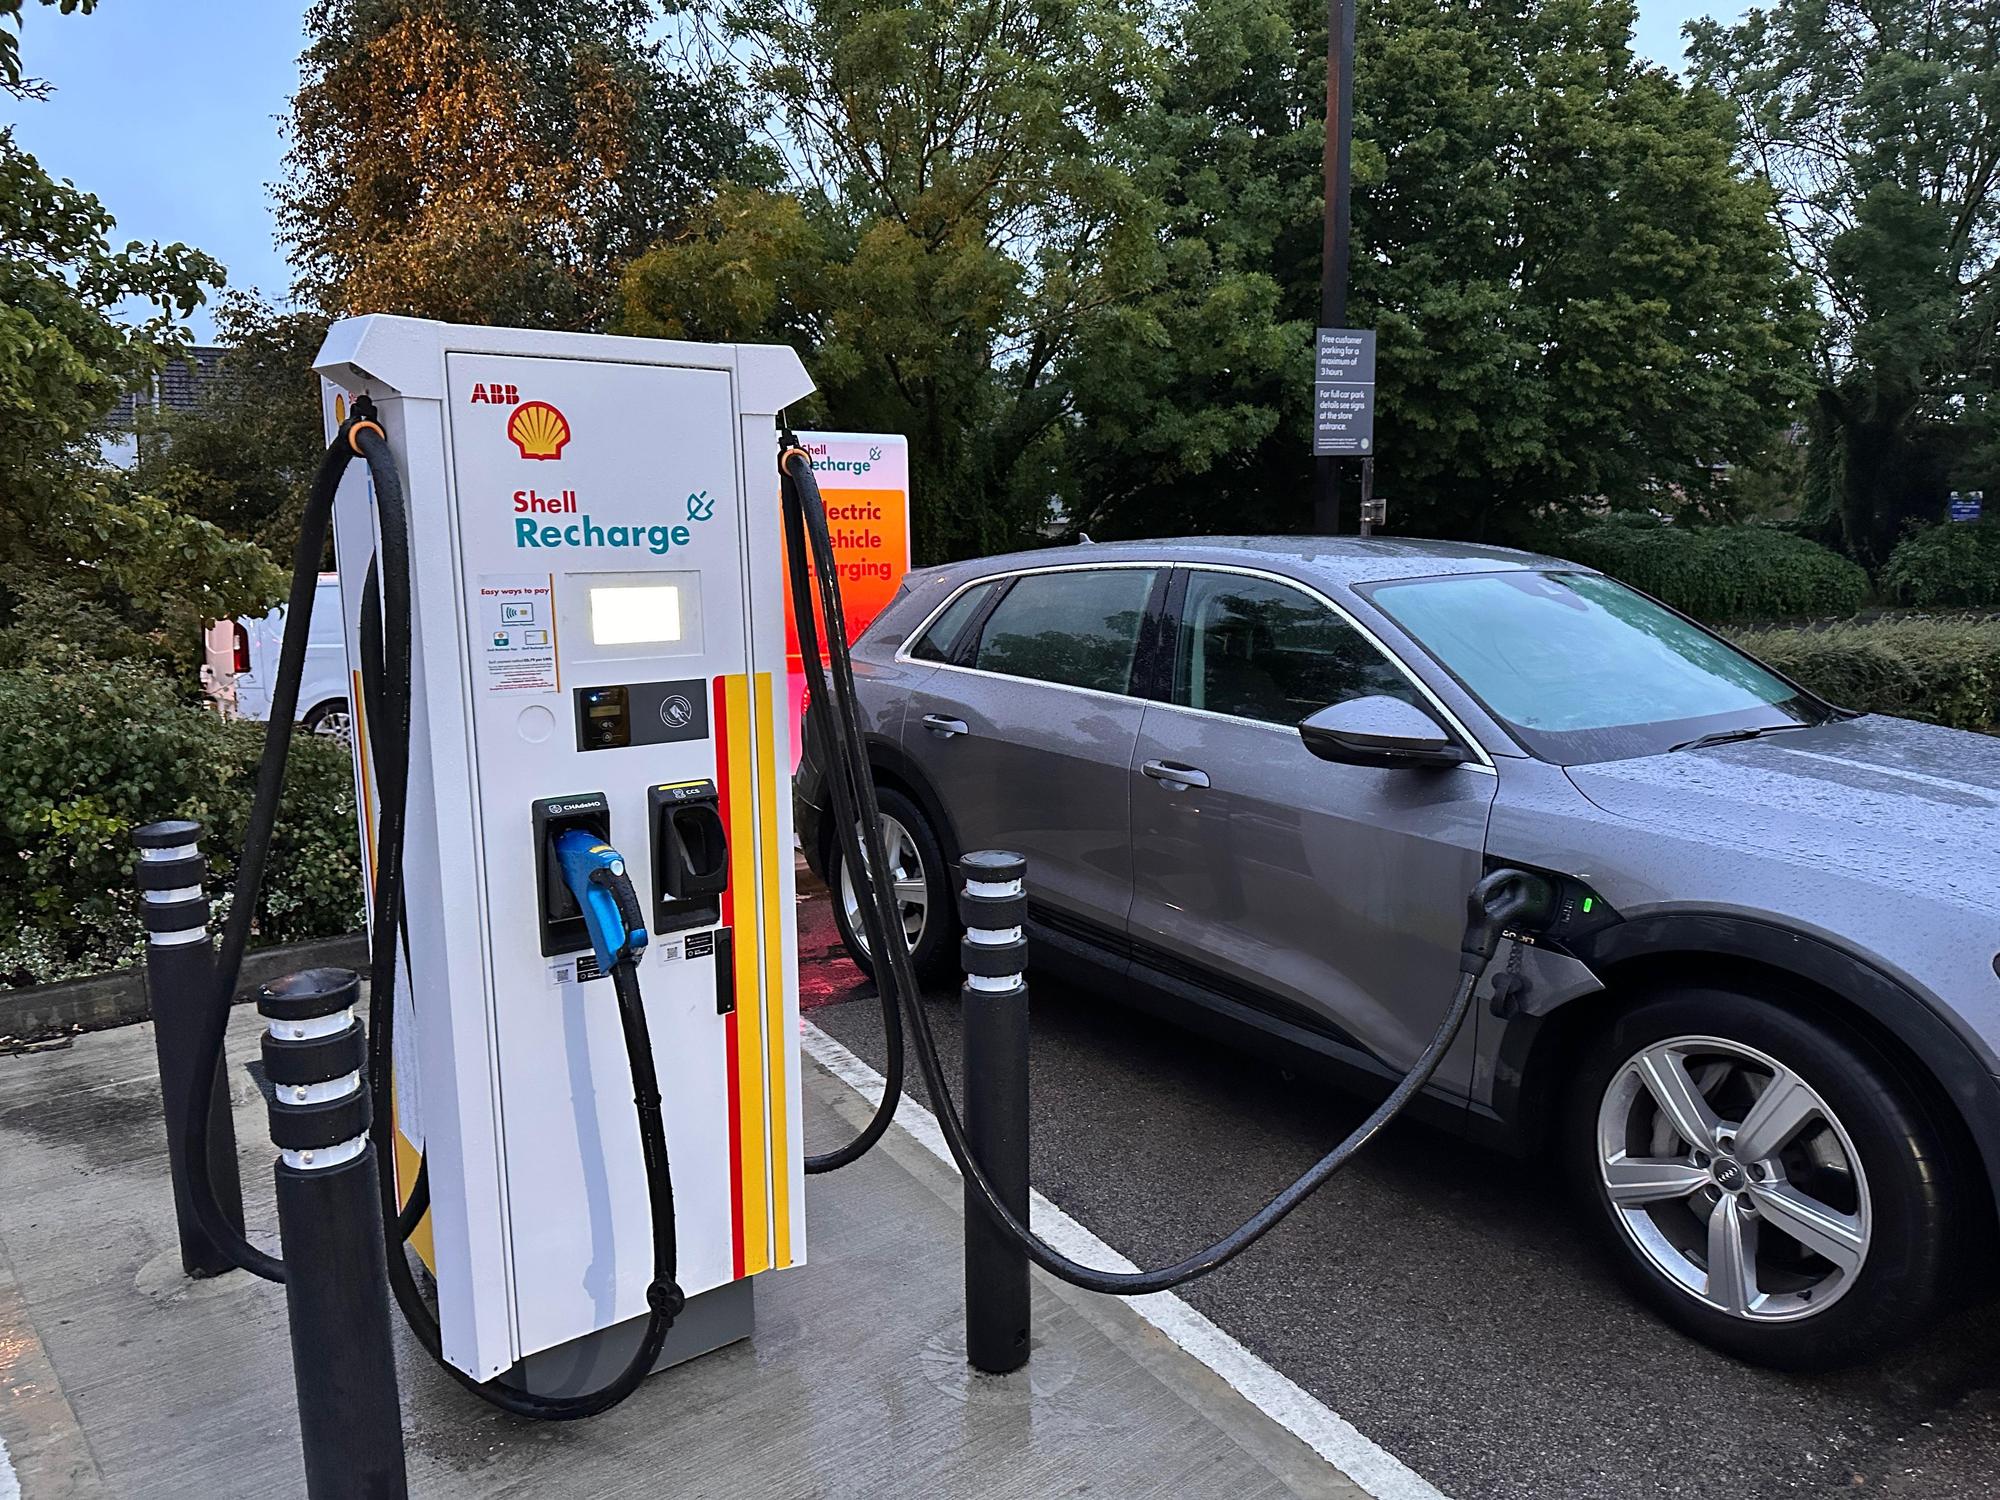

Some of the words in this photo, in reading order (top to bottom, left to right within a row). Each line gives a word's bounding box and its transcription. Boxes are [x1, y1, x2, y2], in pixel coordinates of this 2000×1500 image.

[1321, 334, 1335, 344] Free
[1335, 335, 1362, 345] customer
[1321, 346, 1345, 357] parking
[1345, 346, 1354, 355] for
[1320, 357, 1350, 366] maximum
[1350, 357, 1358, 366] of
[1320, 368, 1326, 376] 3
[1326, 368, 1343, 376] hours
[470, 383, 520, 405] ABB
[1320, 390, 1330, 398] For
[1330, 390, 1340, 398] full
[1350, 390, 1365, 400] park
[1319, 401, 1340, 409] details
[1350, 402, 1365, 411] signs
[1319, 412, 1328, 420] at
[1327, 412, 1338, 420] the
[1337, 412, 1353, 420] store
[1319, 423, 1347, 431] entrance.
[811, 456, 871, 475] echarge
[513, 490, 577, 514] Shell
[822, 500, 881, 520] lectric
[515, 514, 690, 555] Recharge
[829, 529, 882, 549] ehicle
[481, 588, 499, 596] Easy
[534, 588, 550, 596] pay
[685, 788, 701, 796] CCS
[563, 801, 601, 811] CHAdeMO
